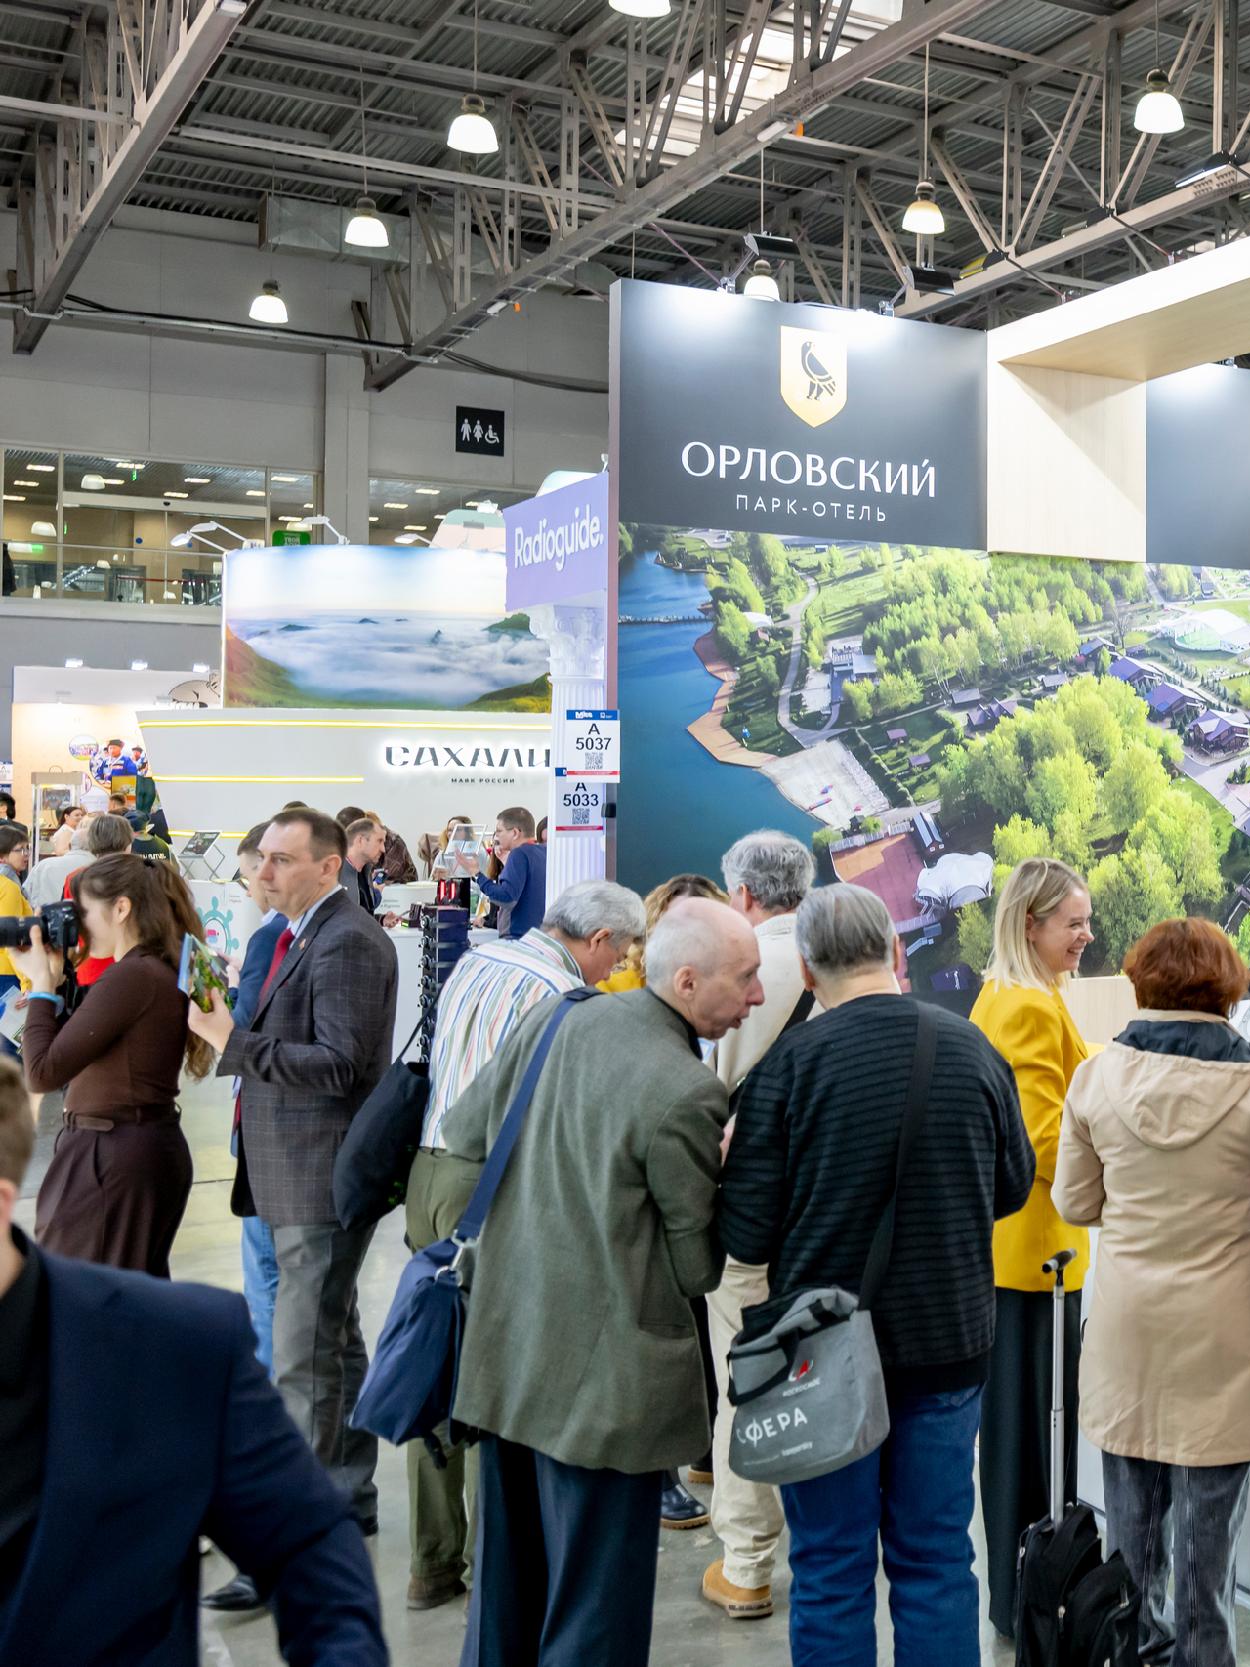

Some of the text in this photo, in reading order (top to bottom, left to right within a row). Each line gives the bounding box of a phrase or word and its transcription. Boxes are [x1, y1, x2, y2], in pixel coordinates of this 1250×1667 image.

[681, 441, 936, 498] ОРЛОВСКИЙ
[736, 494, 887, 522] ПАРК-ОТЕЛЬ
[514, 504, 604, 571] Radioguide.
[588, 723, 601, 735] A
[575, 737, 612, 751] 5037
[385, 746, 551, 768] САХАЛИ
[563, 794, 599, 807] 5033
